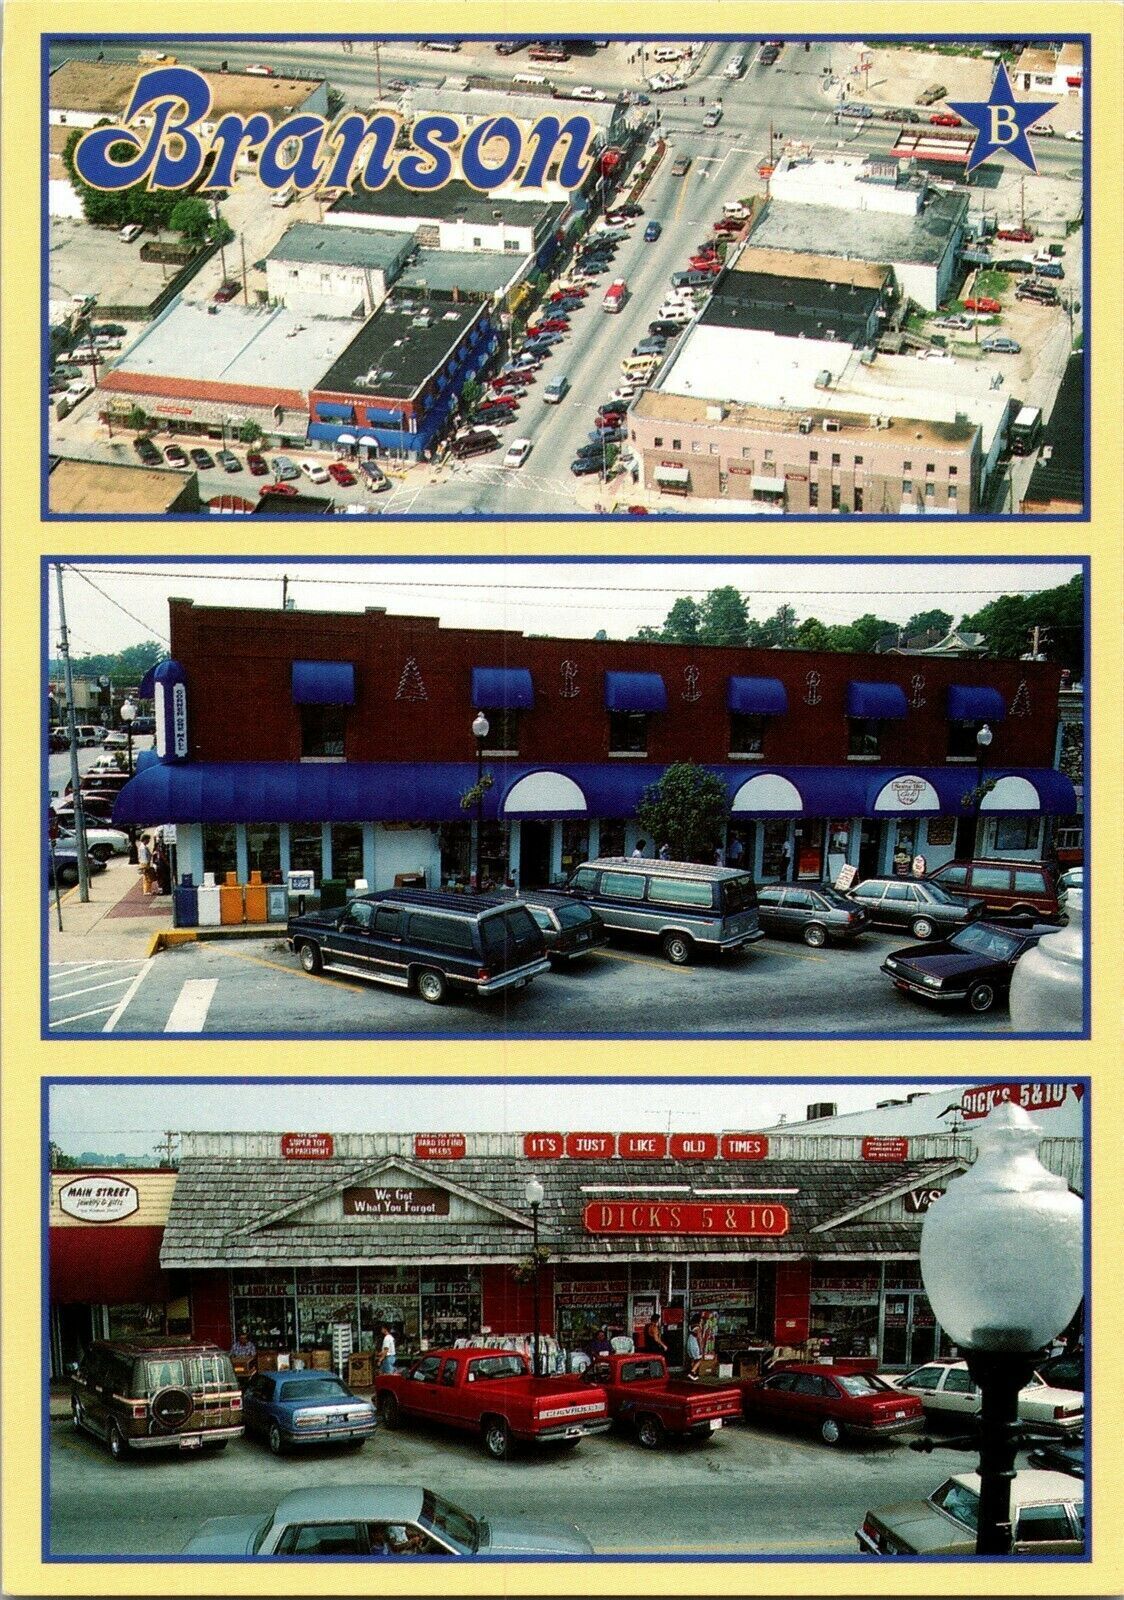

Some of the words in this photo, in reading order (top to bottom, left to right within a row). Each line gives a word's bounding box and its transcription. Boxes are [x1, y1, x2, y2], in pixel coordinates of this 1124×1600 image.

[963, 1086, 1010, 1113] DICK'S
[289, 1138, 312, 1147] SUPER
[313, 1138, 326, 1147] TOY
[418, 1138, 436, 1146] HARD
[437, 1138, 446, 1146] TO
[446, 1138, 464, 1146] FIND
[531, 1138, 557, 1152] IT'S
[575, 1138, 607, 1151] JUST
[629, 1139, 656, 1152] LIKE
[683, 1140, 706, 1153] OLD
[729, 1140, 761, 1153] TIMES
[286, 1147, 329, 1155] DEPARTMENT
[428, 1147, 452, 1155] NEEDS
[68, 1188, 92, 1197] MAIN
[95, 1188, 130, 1197] STREET
[375, 1189, 392, 1200] We
[396, 1189, 412, 1200] Got
[354, 1200, 381, 1212] What
[384, 1201, 401, 1212] You
[405, 1201, 436, 1213] Forgot
[600, 1206, 681, 1228] DICK'S
[702, 1208, 713, 1228] 5
[725, 1208, 738, 1229] &
[749, 1209, 775, 1229] 10
[546, 1405, 598, 1417] CHEVROLET
